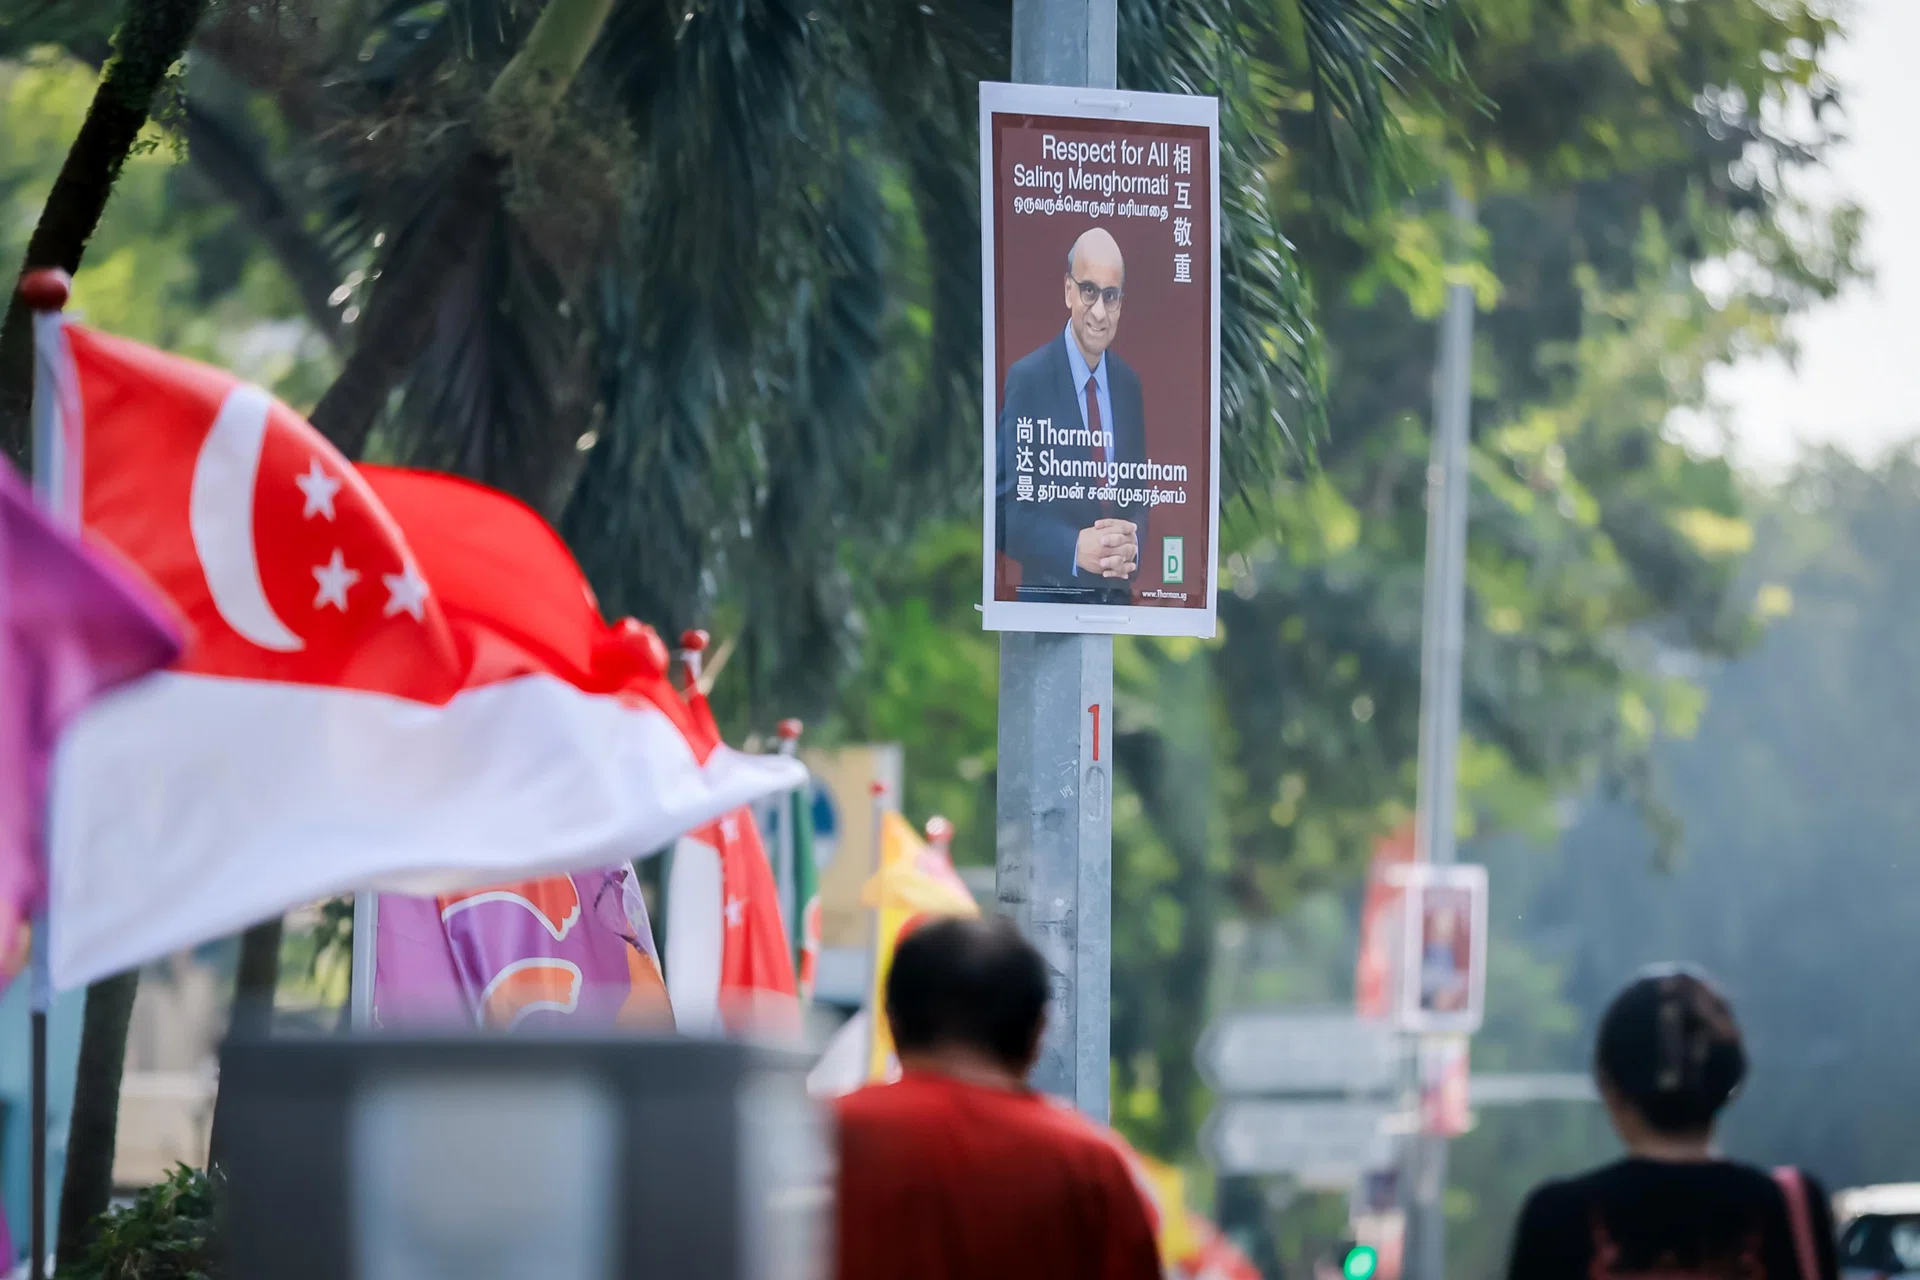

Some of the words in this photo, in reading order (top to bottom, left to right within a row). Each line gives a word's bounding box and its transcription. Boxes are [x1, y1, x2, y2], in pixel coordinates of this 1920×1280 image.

[1042, 134, 1116, 167] Respect
[1121, 142, 1144, 165] for
[1148, 142, 1168, 166] All
[1013, 163, 1063, 194] Saling
[1068, 166, 1169, 197] Menghormati
[1013, 195, 1115, 217] ஒருவருக்கொருவர்
[1117, 199, 1169, 222] மரியாதை
[1173, 143, 1192, 283] 相互敬重
[1037, 418, 1113, 447] Tharman
[1016, 416, 1034, 502] 尚达曼
[1038, 449, 1187, 486] Shanmugaratnam
[1037, 481, 1085, 503] தர்மன்
[1087, 485, 1186, 508] சண்முகரத்னம்
[1168, 555, 1178, 574] D
[1141, 589, 1187, 602] www.Tharman.sg
